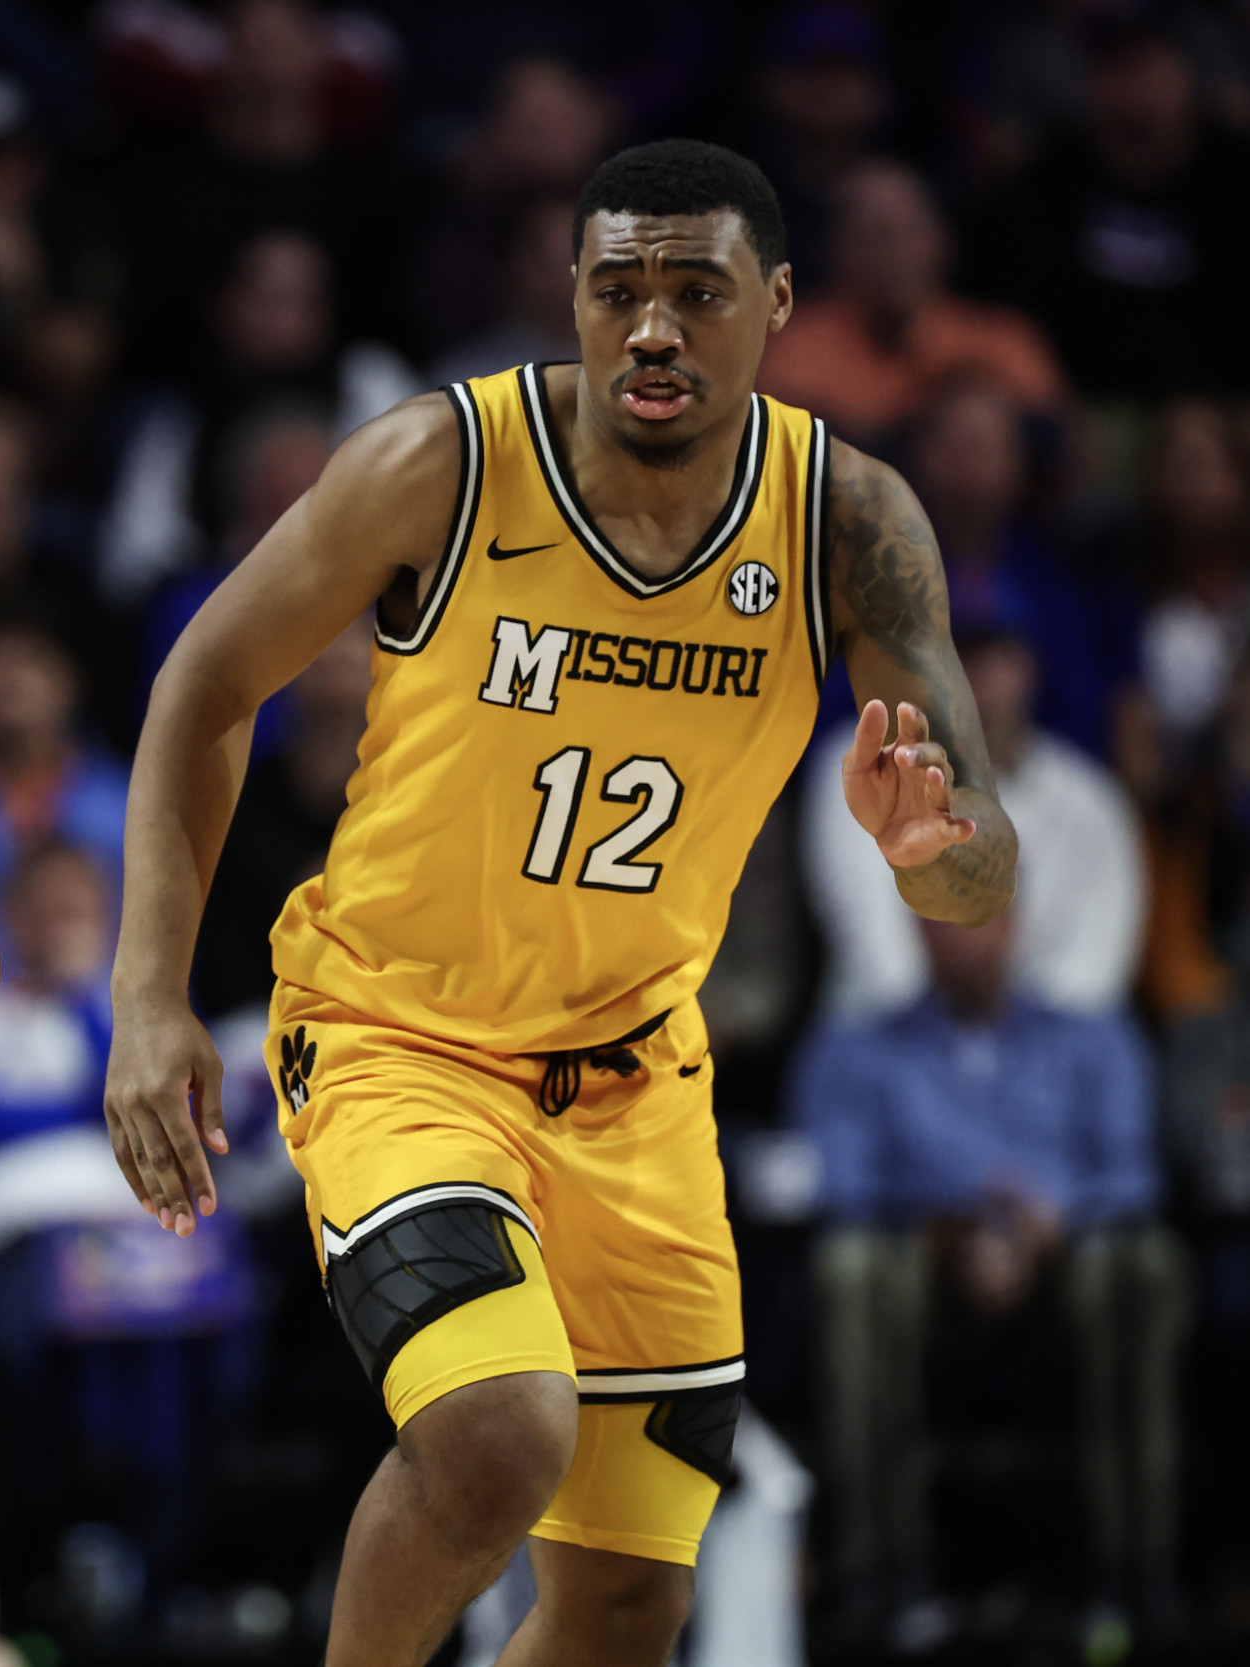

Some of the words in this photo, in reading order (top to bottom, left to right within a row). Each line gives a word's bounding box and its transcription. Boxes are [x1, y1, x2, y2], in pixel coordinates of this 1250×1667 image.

[730, 562, 777, 614] SEC
[478, 615, 768, 715] MISSOURI
[521, 745, 685, 894] 12
